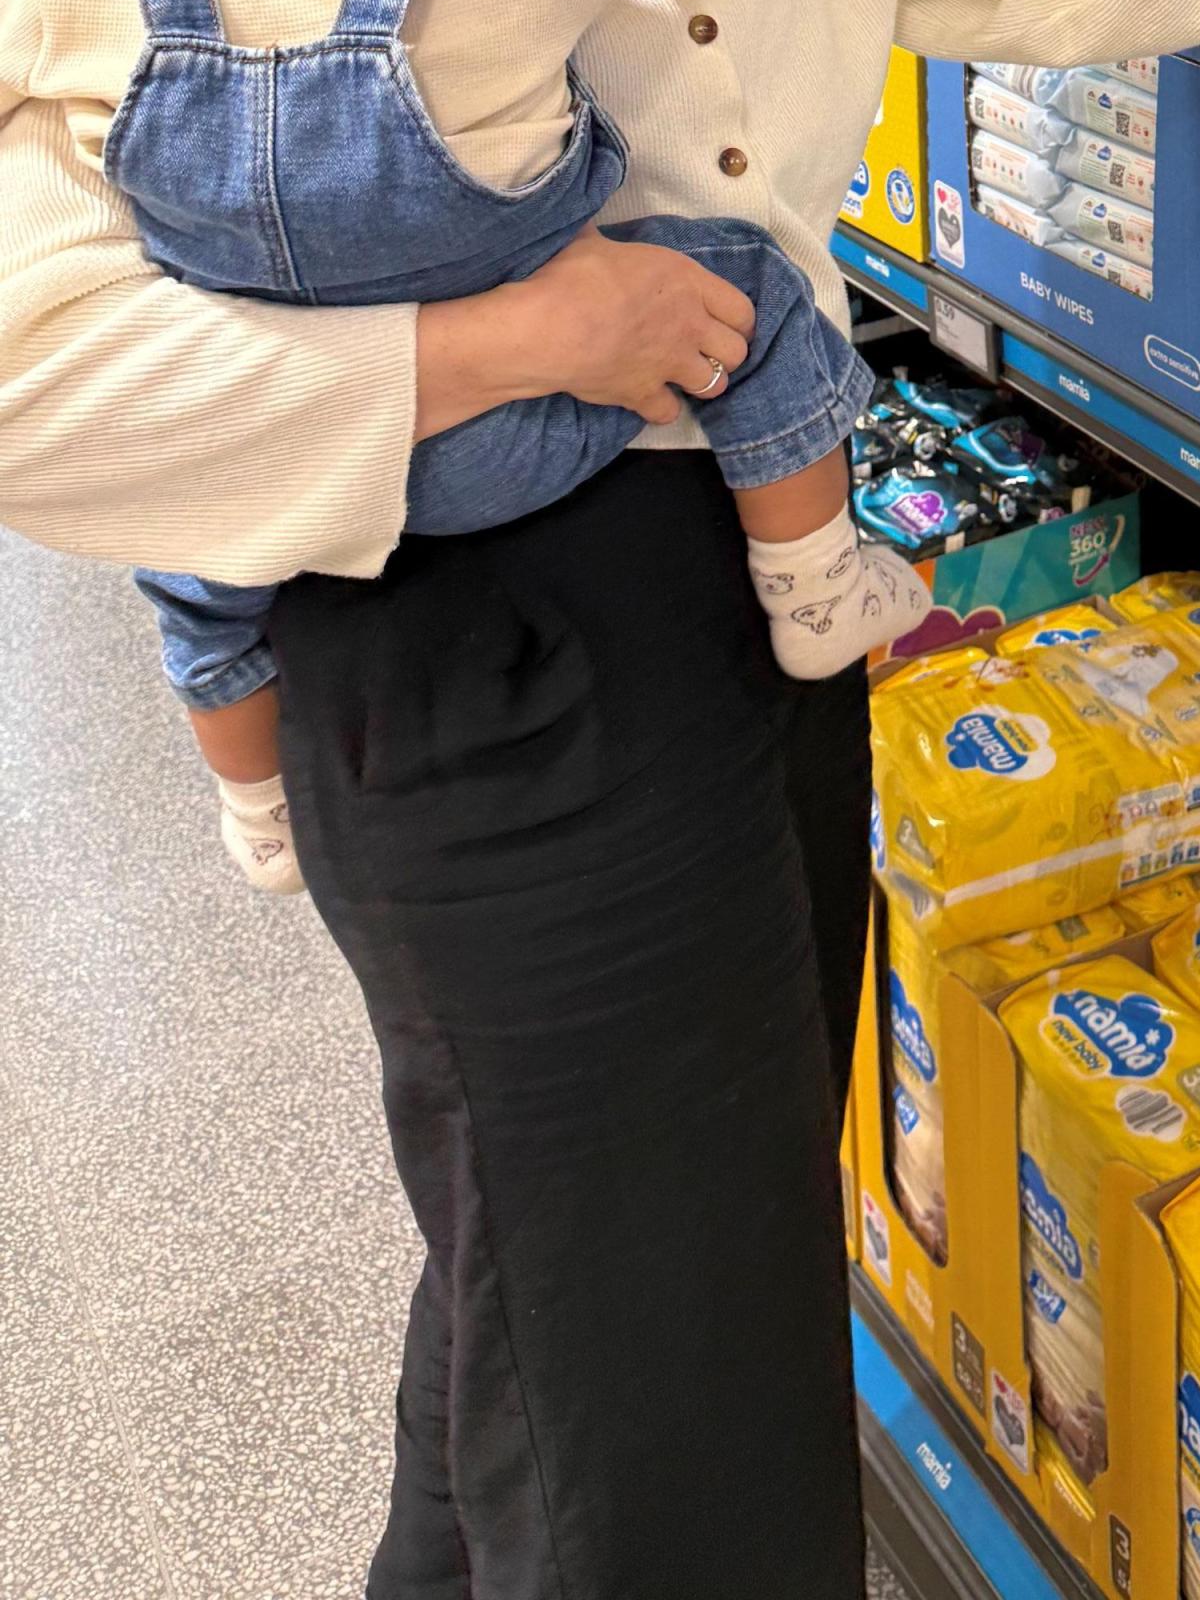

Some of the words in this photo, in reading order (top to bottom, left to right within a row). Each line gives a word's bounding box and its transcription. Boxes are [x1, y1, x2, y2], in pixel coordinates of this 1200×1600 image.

[1020, 272, 1052, 301] BABY
[1054, 290, 1096, 326] WIPES
[1058, 377, 1091, 403] mamia
[957, 714, 1017, 773] mamia
[1052, 1018, 1076, 1048] new
[1070, 1038, 1104, 1072] baby
